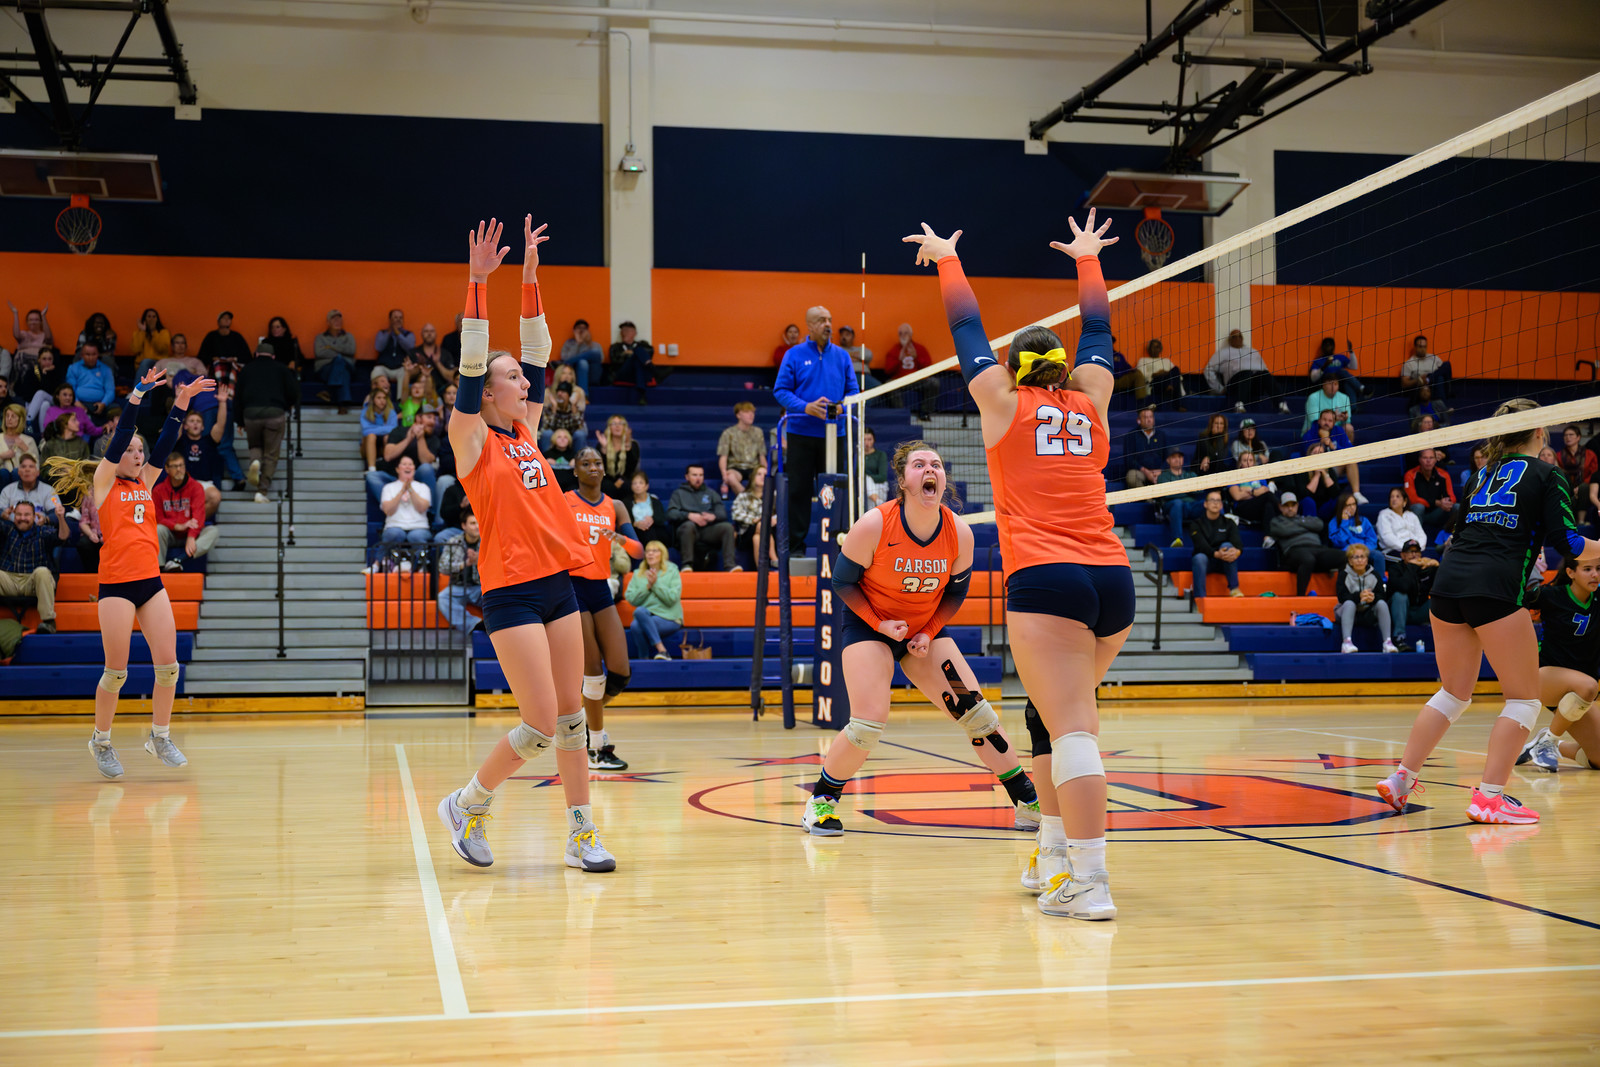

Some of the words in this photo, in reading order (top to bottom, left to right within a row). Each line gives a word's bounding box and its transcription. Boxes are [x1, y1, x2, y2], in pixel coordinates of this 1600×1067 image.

[1034, 404, 1093, 457] 29
[518, 457, 549, 490] 21
[1469, 459, 1529, 509] 12
[133, 503, 145, 525] 8
[575, 512, 611, 526] CARSON
[588, 525, 600, 546] 5
[893, 556, 948, 574] CARSON
[901, 575, 941, 593] 32
[817, 516, 833, 723] CARSON
[1572, 612, 1591, 636] 7
